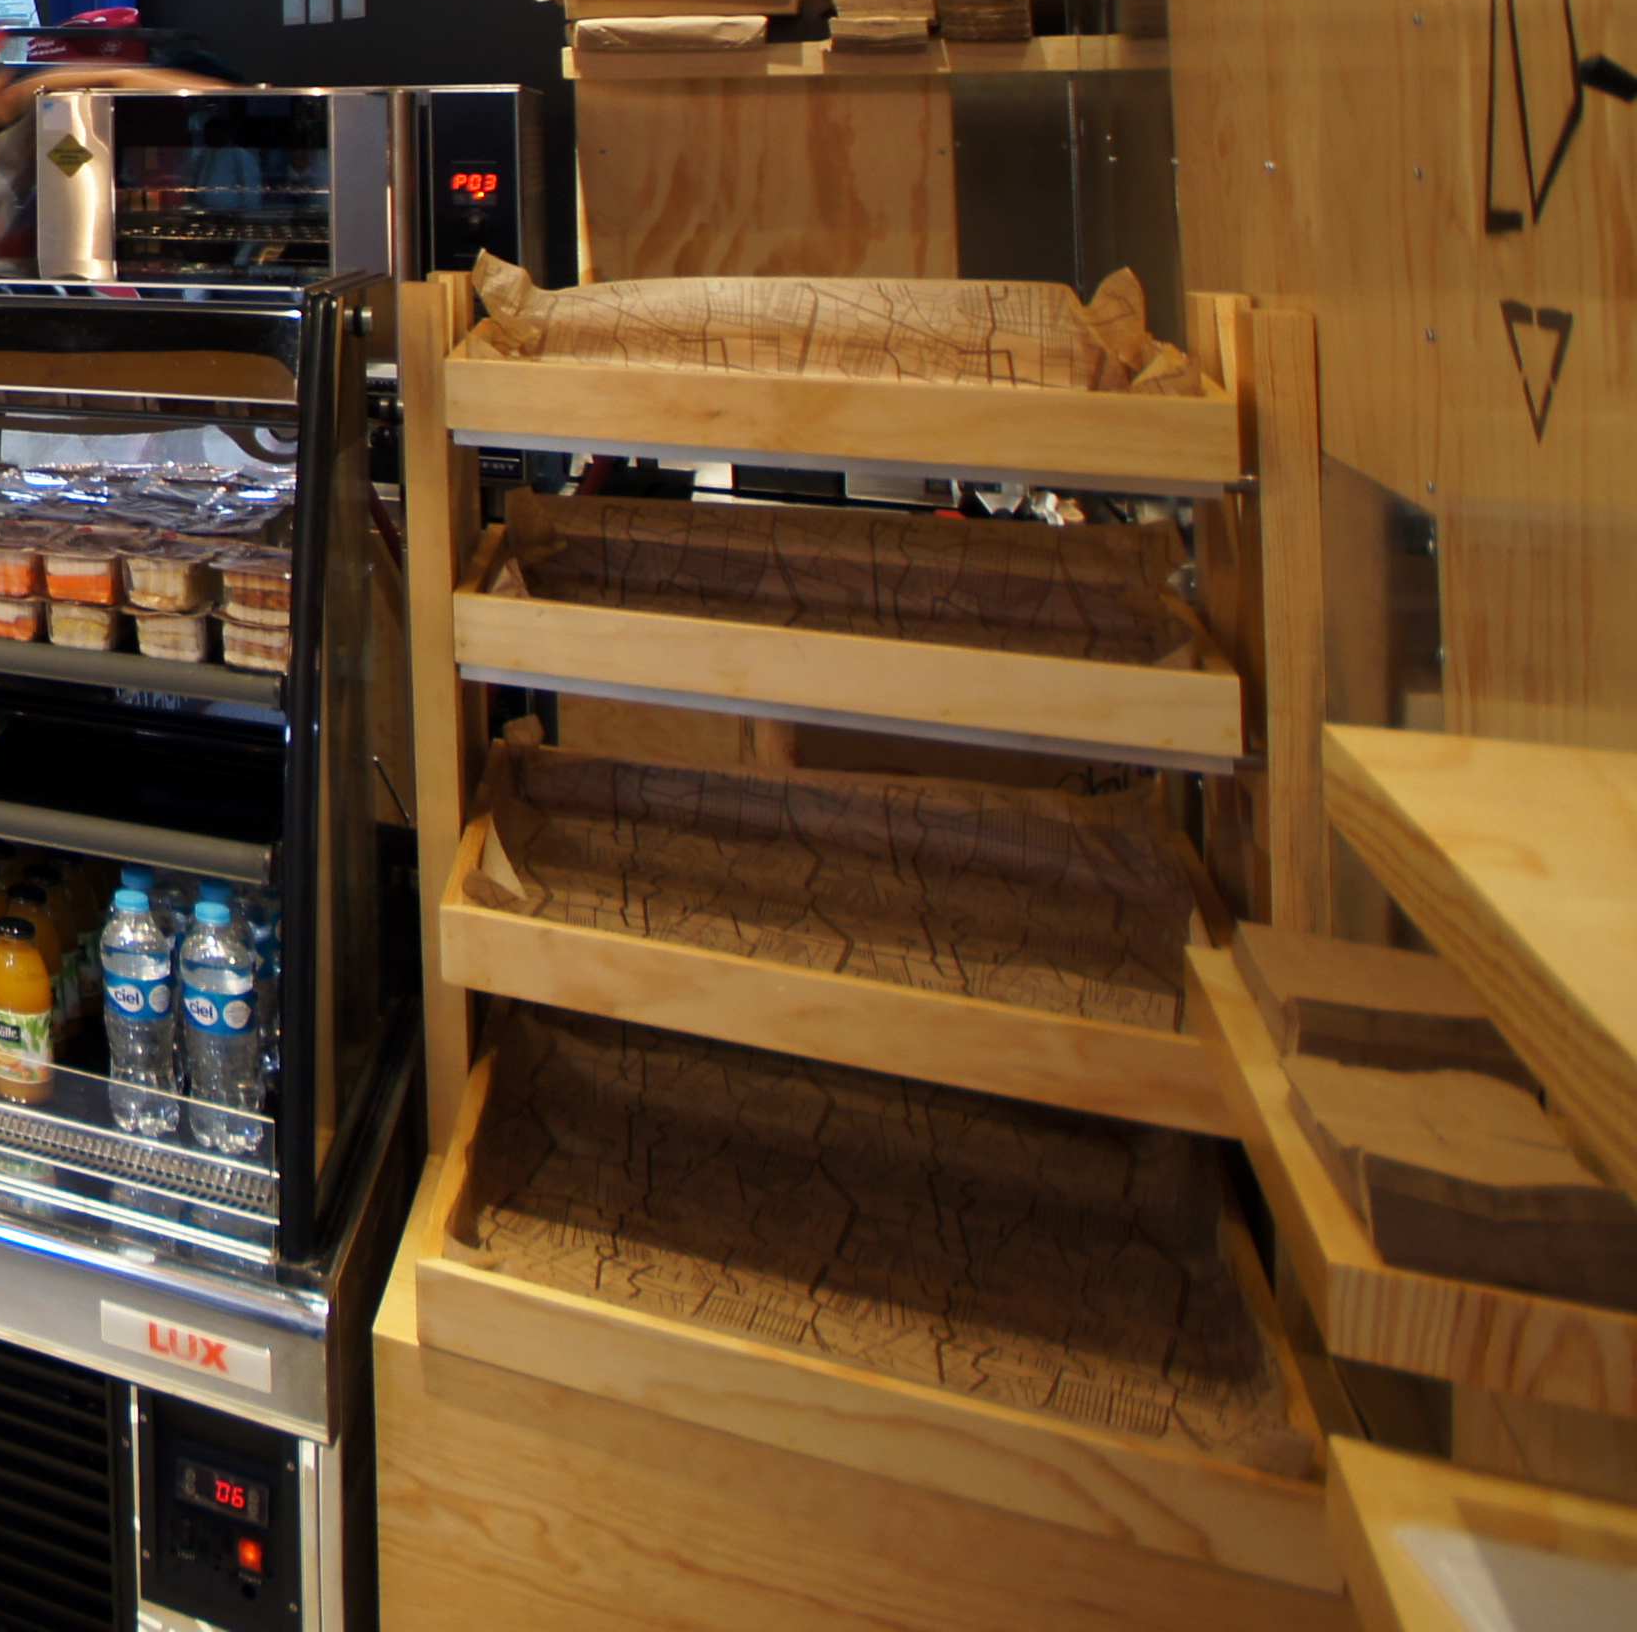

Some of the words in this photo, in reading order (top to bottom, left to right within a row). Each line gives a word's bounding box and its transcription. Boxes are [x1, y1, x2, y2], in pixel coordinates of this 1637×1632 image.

[451, 173, 498, 192] P03
[114, 988, 140, 1006] ciel
[189, 1000, 214, 1019] ciel
[148, 1321, 230, 1373] LUX
